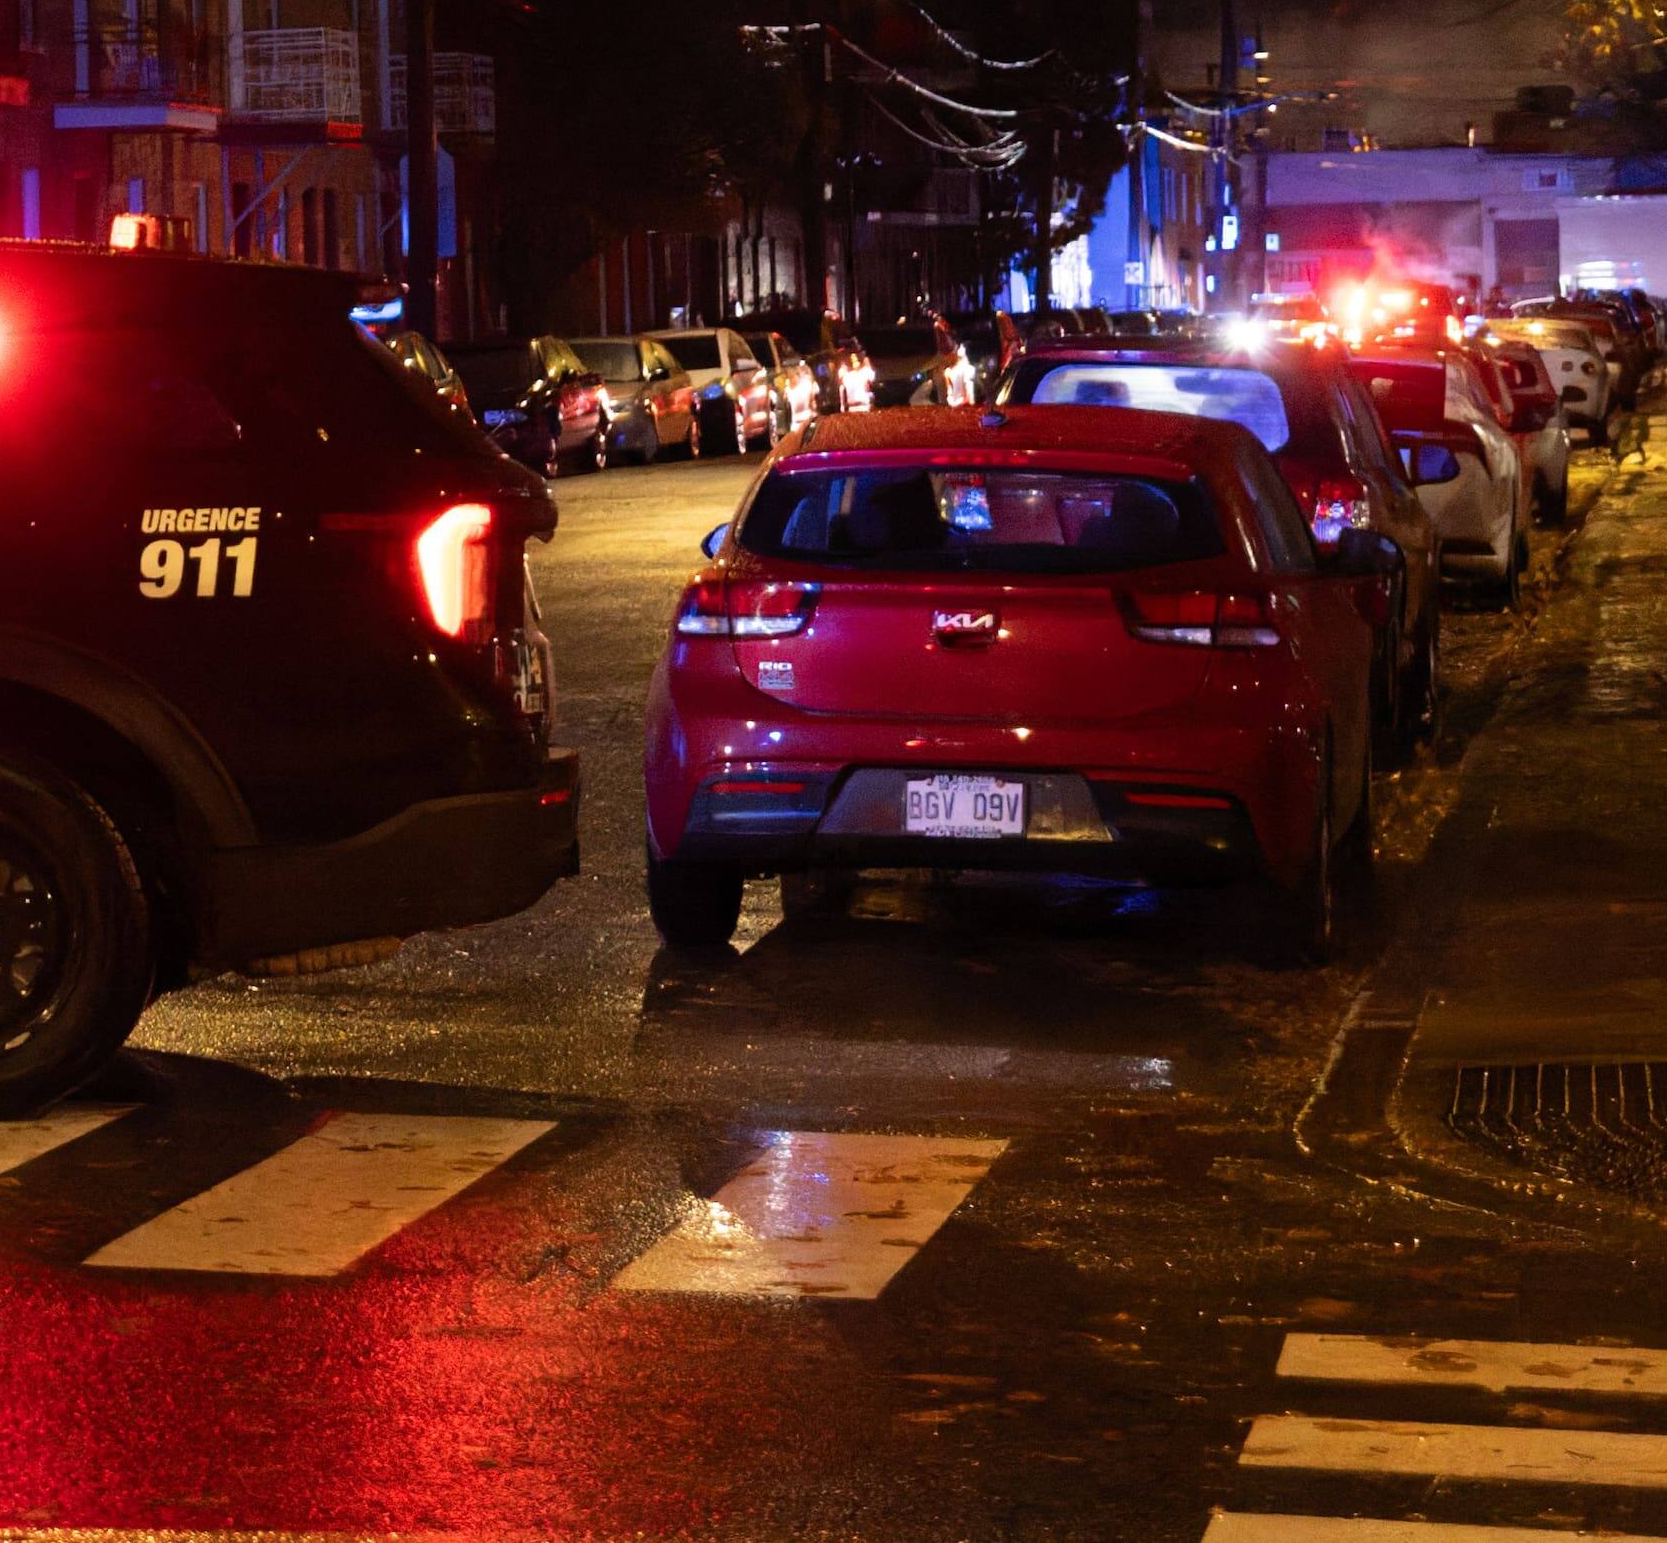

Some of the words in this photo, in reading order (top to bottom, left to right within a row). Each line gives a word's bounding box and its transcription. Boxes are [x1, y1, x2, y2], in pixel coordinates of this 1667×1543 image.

[141, 507, 261, 533] URGENCE
[139, 537, 257, 598] 911
[937, 613, 994, 628] KIA
[759, 662, 792, 670] RIO
[909, 791, 955, 820] BGV
